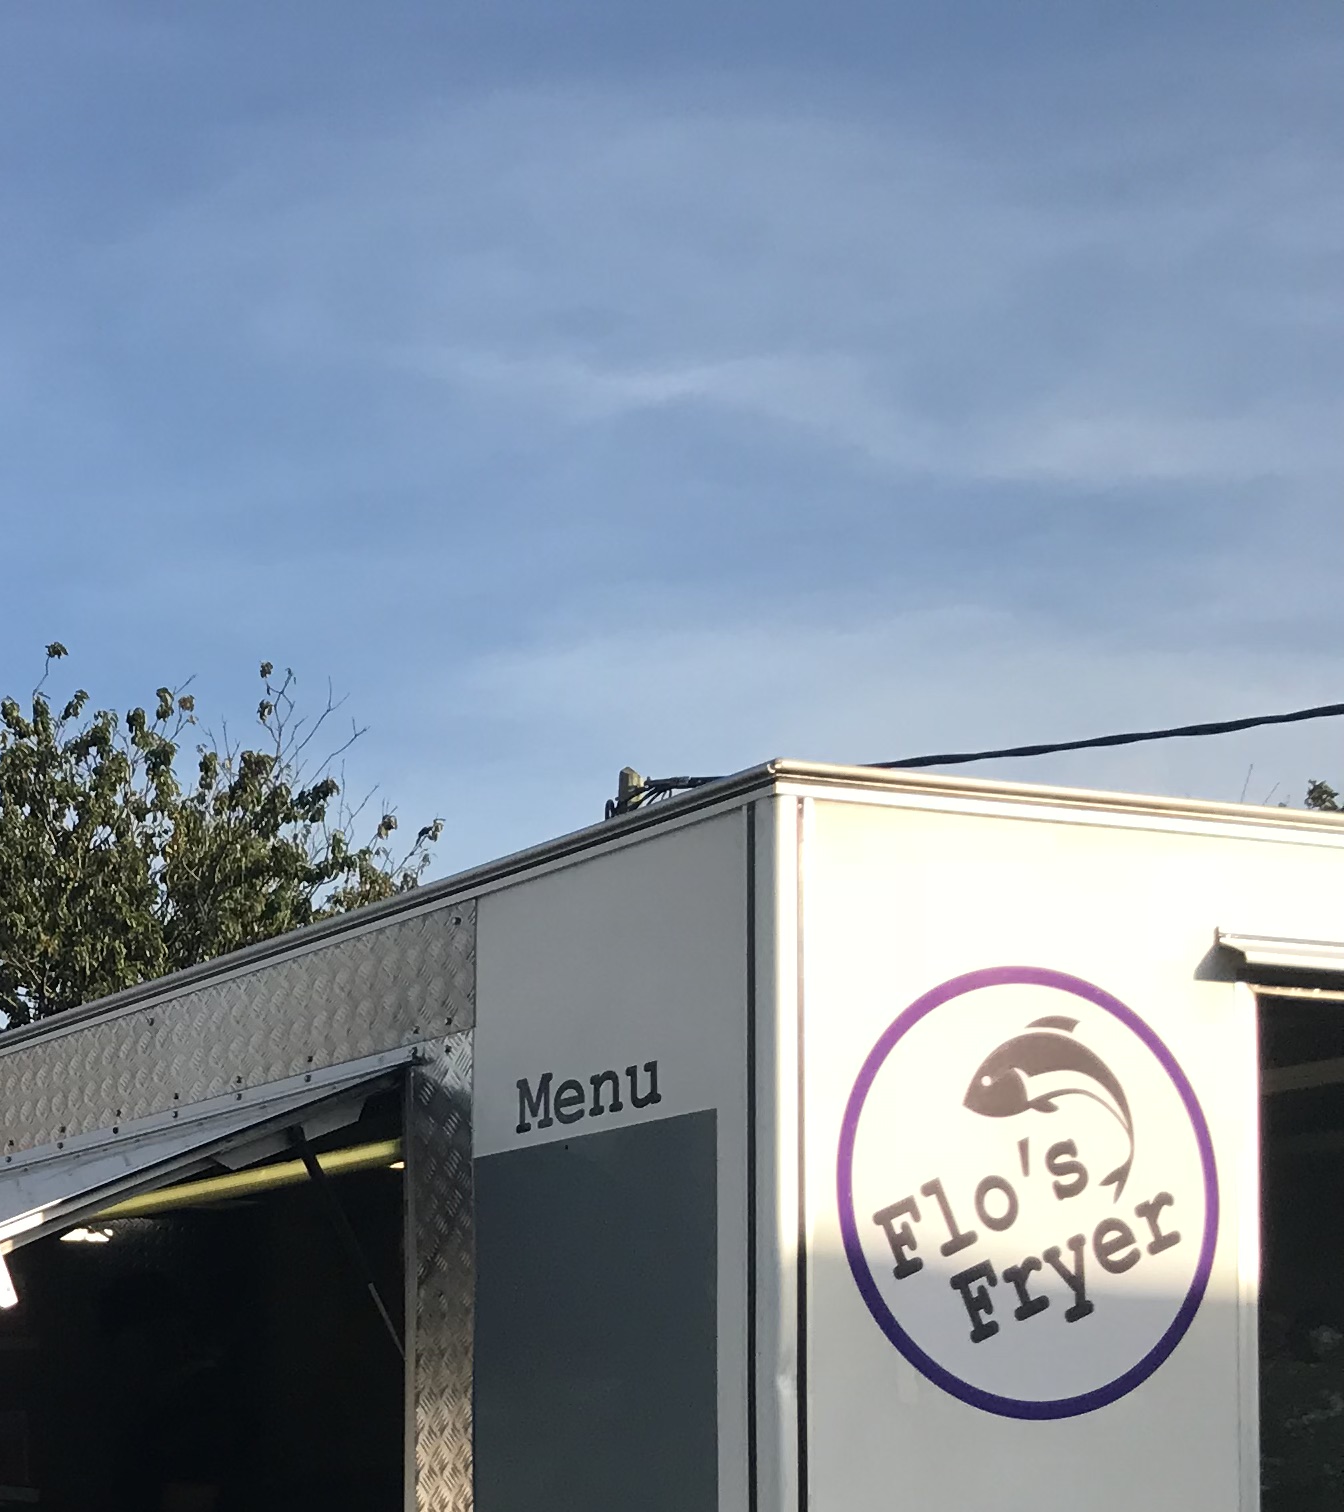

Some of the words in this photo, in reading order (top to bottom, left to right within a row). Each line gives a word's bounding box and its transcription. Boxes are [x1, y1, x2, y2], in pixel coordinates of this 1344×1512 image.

[515, 1060, 662, 1134] Menu
[872, 1137, 1089, 1280] Flo's
[950, 1191, 1182, 1344] Fryer
